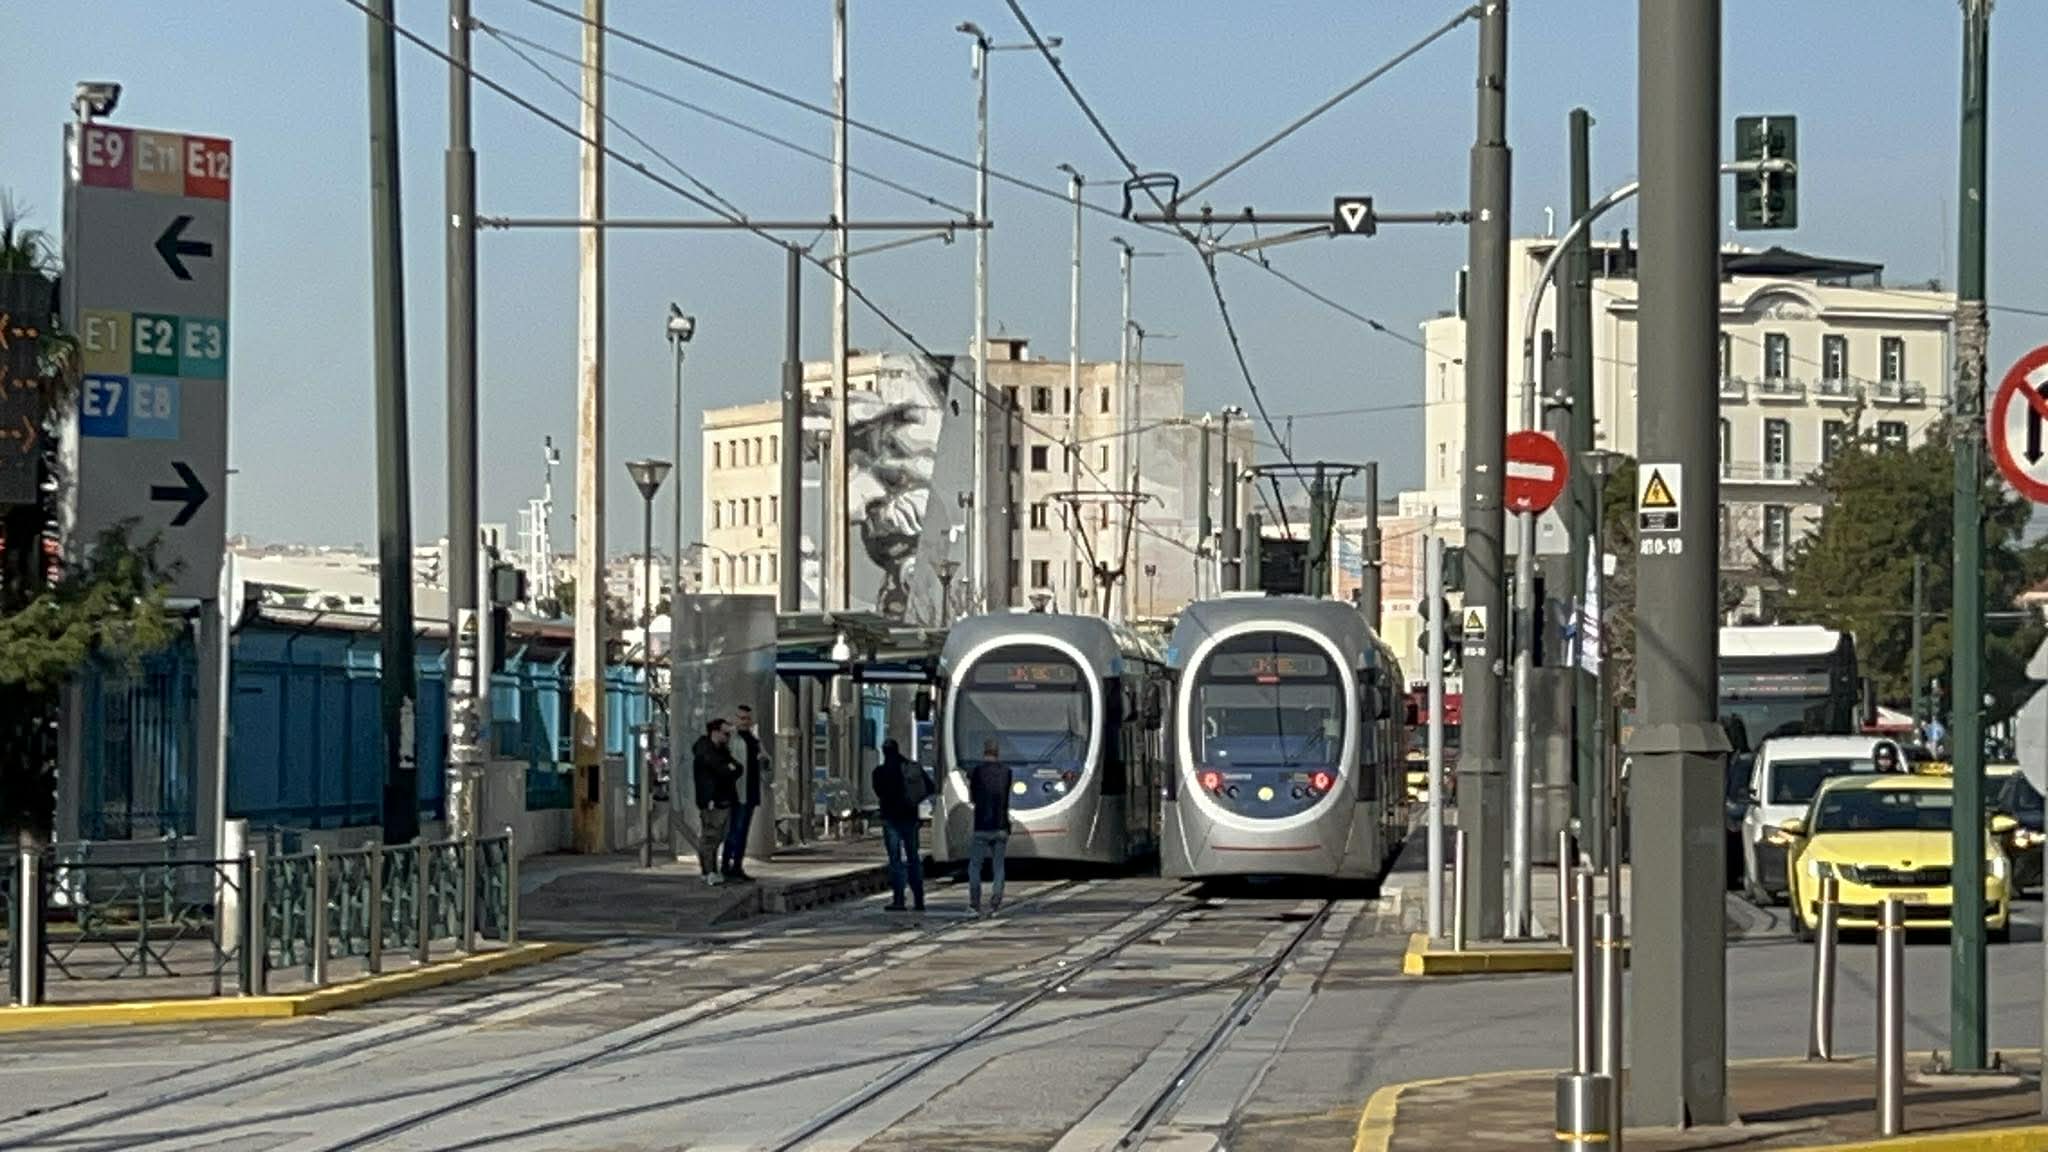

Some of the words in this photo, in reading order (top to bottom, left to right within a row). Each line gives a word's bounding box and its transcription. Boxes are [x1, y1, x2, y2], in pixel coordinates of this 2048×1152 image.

[87, 129, 124, 168] E9
[138, 135, 177, 174] E11
[188, 141, 229, 180] E12
[85, 317, 118, 351] E1
[135, 318, 174, 356] E2
[185, 321, 222, 359] E3
[82, 379, 123, 417] E7
[134, 382, 171, 419] E8
